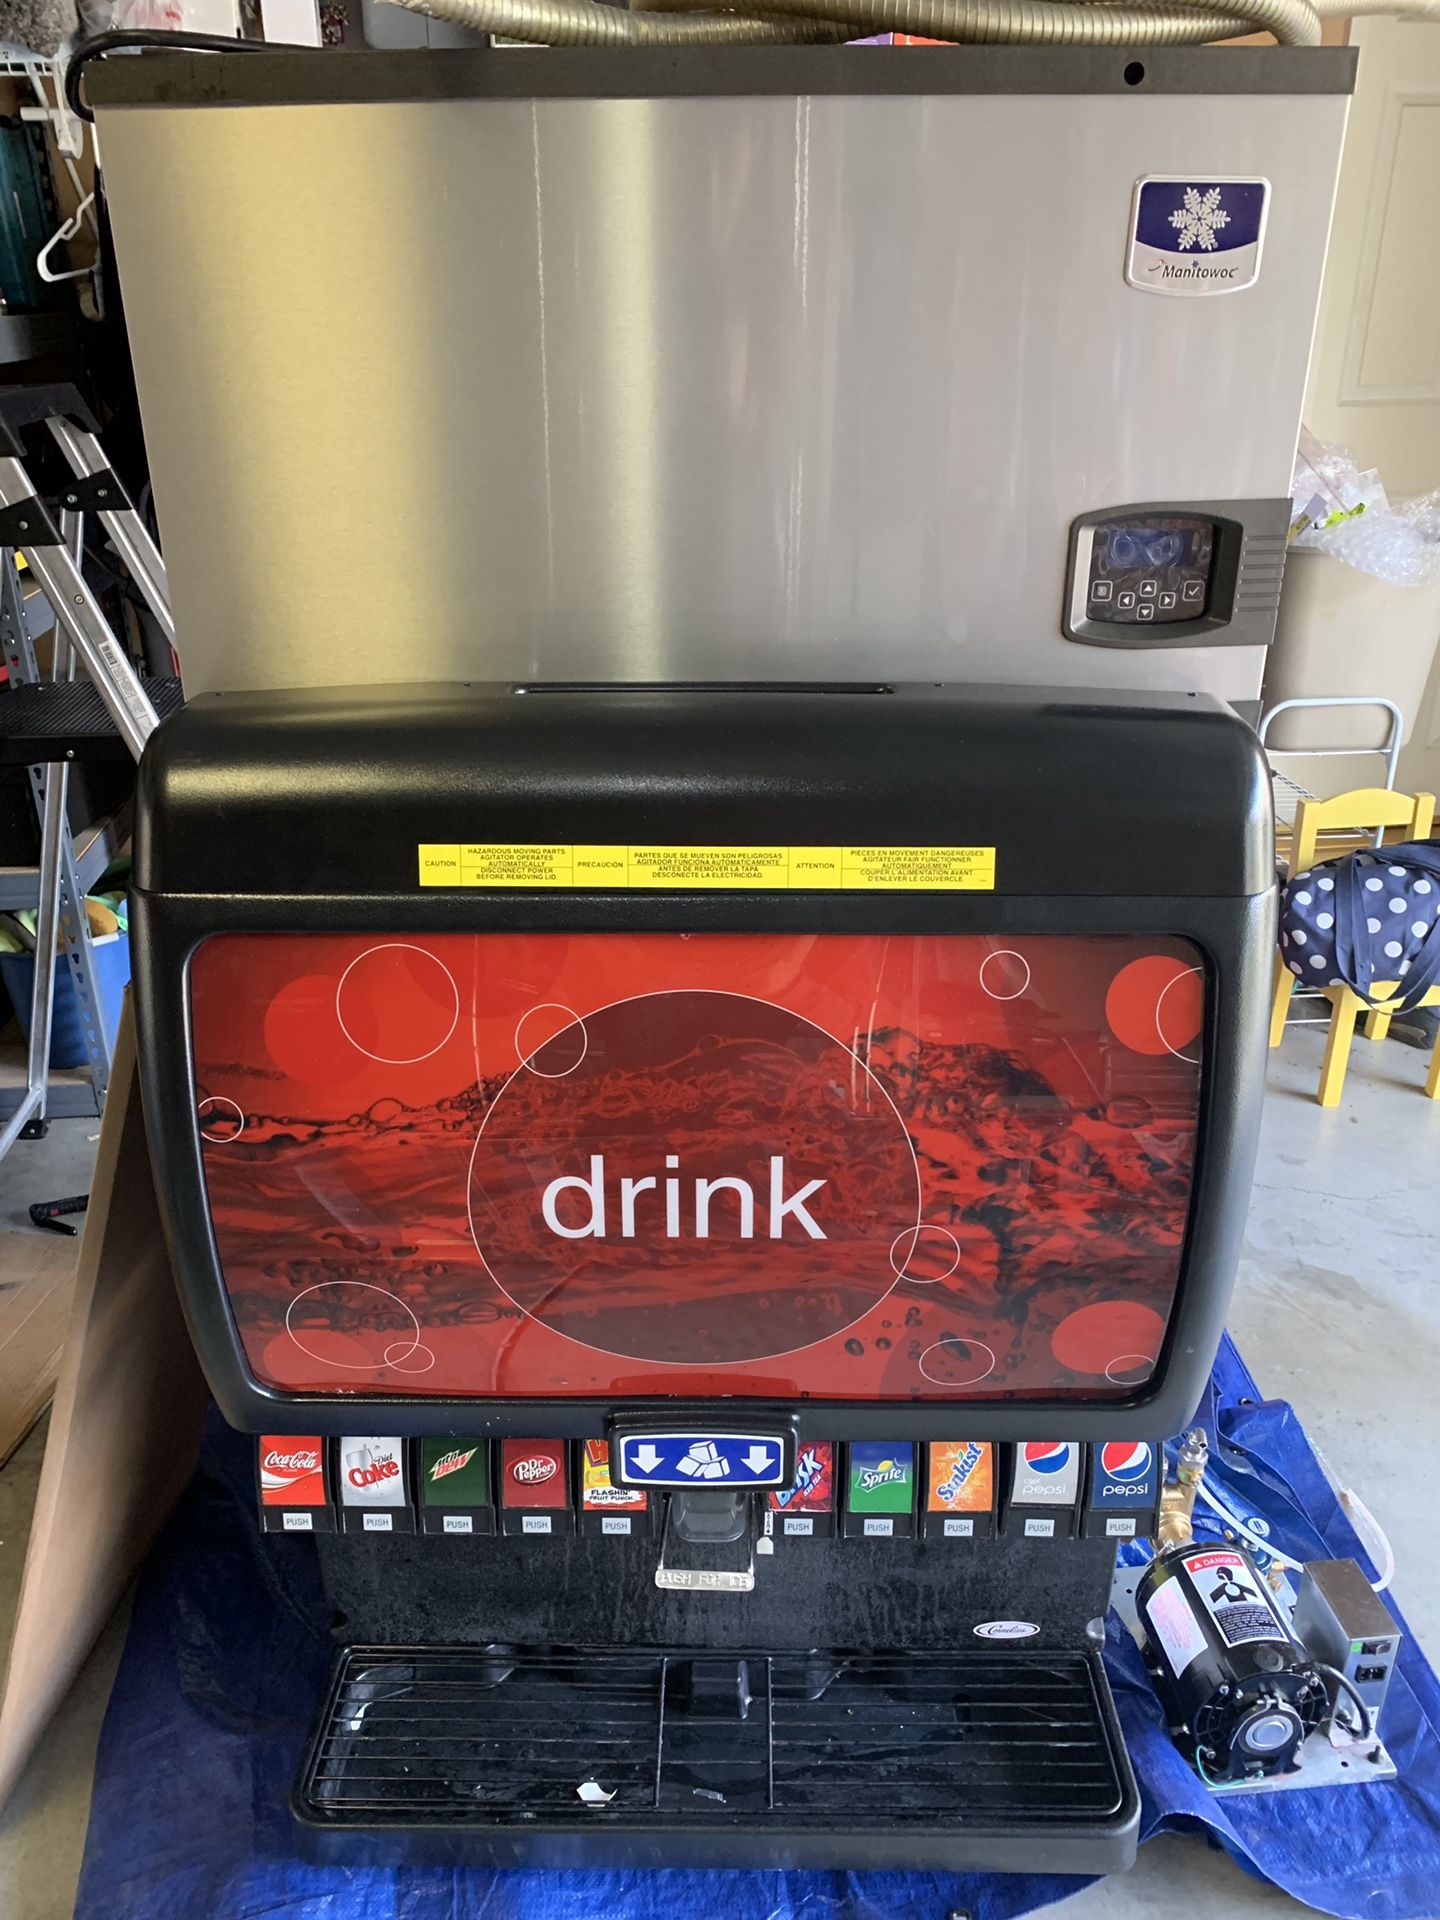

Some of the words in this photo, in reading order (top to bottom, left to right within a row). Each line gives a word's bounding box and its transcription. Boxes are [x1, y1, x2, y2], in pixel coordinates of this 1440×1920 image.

[1161, 263, 1236, 279] Manitowoc
[541, 1154, 828, 1240] drink
[264, 1450, 319, 1469] Coca-Cola
[374, 1453, 392, 1464] Diet
[528, 1458, 544, 1469] Dr
[348, 1460, 400, 1488] Coke
[520, 1461, 554, 1480] Pepper
[937, 1442, 983, 1501] Sunkist
[860, 1466, 902, 1488] Sprite
[1022, 1484, 1066, 1496] pepsi
[1102, 1482, 1149, 1496] pepsi
[286, 1518, 309, 1526] PUSH
[366, 1518, 389, 1527] PUSH
[446, 1520, 469, 1529] PUSH
[526, 1521, 548, 1529] PUSH
[605, 1522, 628, 1530] PUSH
[788, 1523, 810, 1531] PUSH
[867, 1524, 890, 1532] PUSH
[947, 1524, 970, 1532] PUSH
[1028, 1524, 1050, 1532] PUSH
[1110, 1524, 1132, 1532] PUSH
[1202, 1554, 1240, 1567] DANGER
